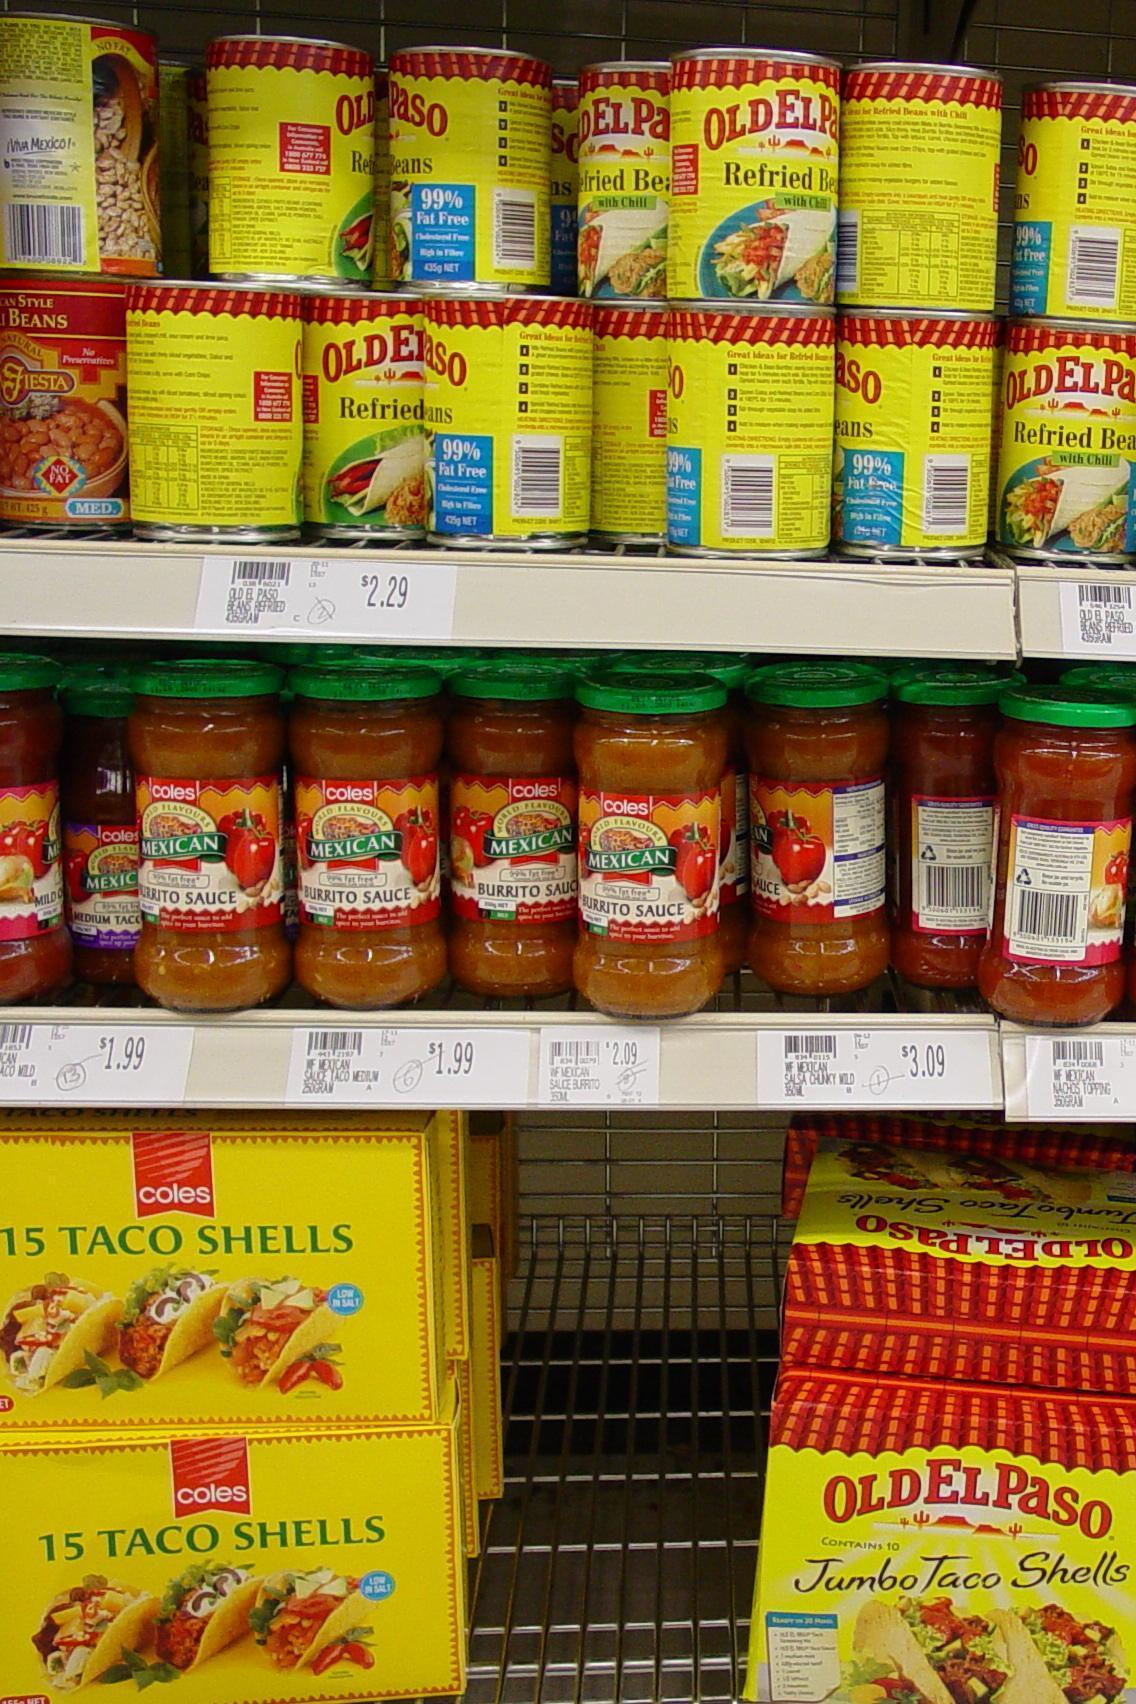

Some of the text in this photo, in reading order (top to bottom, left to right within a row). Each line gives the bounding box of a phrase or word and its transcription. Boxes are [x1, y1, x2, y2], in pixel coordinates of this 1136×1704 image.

[703, 98, 773, 151] OLD
[723, 161, 813, 192] Refried
[420, 187, 463, 210] 99%
[415, 211, 470, 227] Fat Free
[444, 263, 460, 274] NET
[18, 295, 54, 309] STYLE
[9, 311, 69, 329] BEANS
[82, 348, 95, 358] No
[322, 332, 388, 384] OLD
[339, 396, 425, 422] Refried
[1014, 420, 1092, 450] Refried
[442, 438, 481, 462] 99%
[1060, 453, 1084, 465] with
[50, 463, 70, 476] NO
[438, 463, 487, 479] Fat Free
[852, 453, 892, 477] 99%
[49, 472, 72, 485] FAT
[847, 476, 867, 490] Fat
[75, 502, 118, 515] MED.
[361, 574, 409, 608] $2.29
[254, 601, 286, 614] REFRIED
[152, 784, 196, 800] coles
[326, 786, 373, 801] coles
[512, 783, 558, 798] coles
[603, 799, 649, 815] coles
[102, 829, 139, 843] coles
[490, 828, 573, 857] MEXICAN
[142, 835, 218, 857] MEXICAN
[310, 836, 396, 858] MEXICAN
[588, 850, 670, 870] MEXICAN
[304, 885, 412, 904] BURRITO SAUCE
[478, 879, 577, 898] BURRITO SAUC
[185, 891, 237, 906] SAUCE
[582, 895, 685, 918] BURRITO SAUCE
[74, 911, 111, 925] MEDIUM
[100, 1037, 146, 1071] $1.99
[428, 1040, 474, 1076] $1.99
[606, 1041, 639, 1067] $2.09
[901, 1044, 945, 1078] $3.09
[304, 1070, 328, 1083] SAUCE
[352, 1071, 379, 1083] MEDIUM
[549, 1078, 601, 1091] SAUCE BURRITO
[784, 1073, 855, 1086] SALSA CHUNKY MILD
[1053, 1082, 1111, 1096] NACHOS TOPPING
[138, 1183, 211, 1205] coles
[0, 1223, 354, 1258] 15 TACO SHELLS
[336, 1288, 356, 1299] LOW
[176, 1484, 248, 1506] coles
[822, 1468, 922, 1525] OLD
[925, 1457, 990, 1506] EL
[37, 1514, 387, 1563] 15 TACO SHELLS
[820, 1536, 900, 1552] CONTAINS 10
[368, 1575, 387, 1586] LOW
[793, 1549, 1132, 1594] Jumbo Taco Shells
